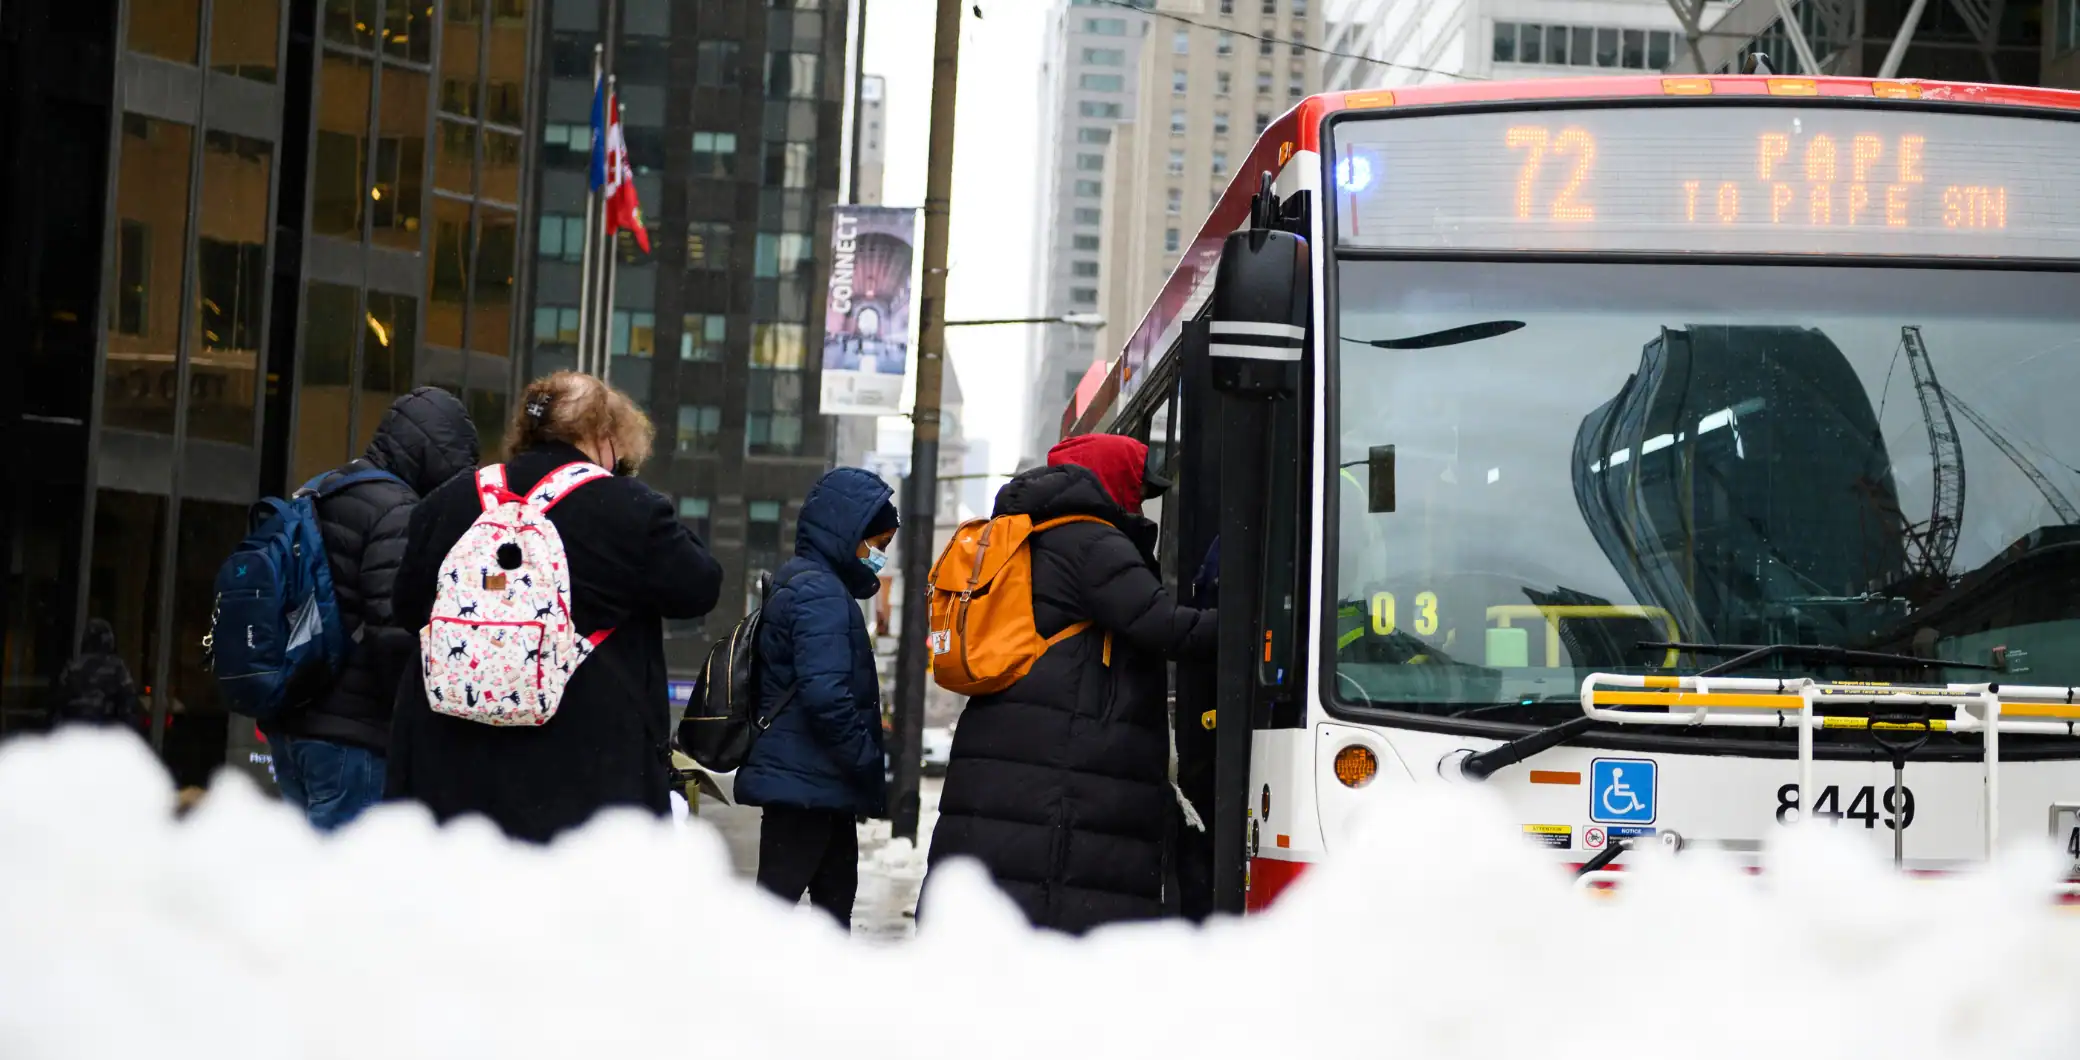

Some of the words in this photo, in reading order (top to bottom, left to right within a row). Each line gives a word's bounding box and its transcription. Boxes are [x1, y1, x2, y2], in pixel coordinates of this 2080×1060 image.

[1506, 127, 1594, 219] 72
[1760, 132, 1926, 182] PAPE
[1684, 181, 1739, 223] TO
[1773, 183, 1909, 226] PAPE
[1943, 185, 2007, 228] STN
[831, 212, 858, 314] CONNECT
[1776, 783, 1916, 831] 8449
